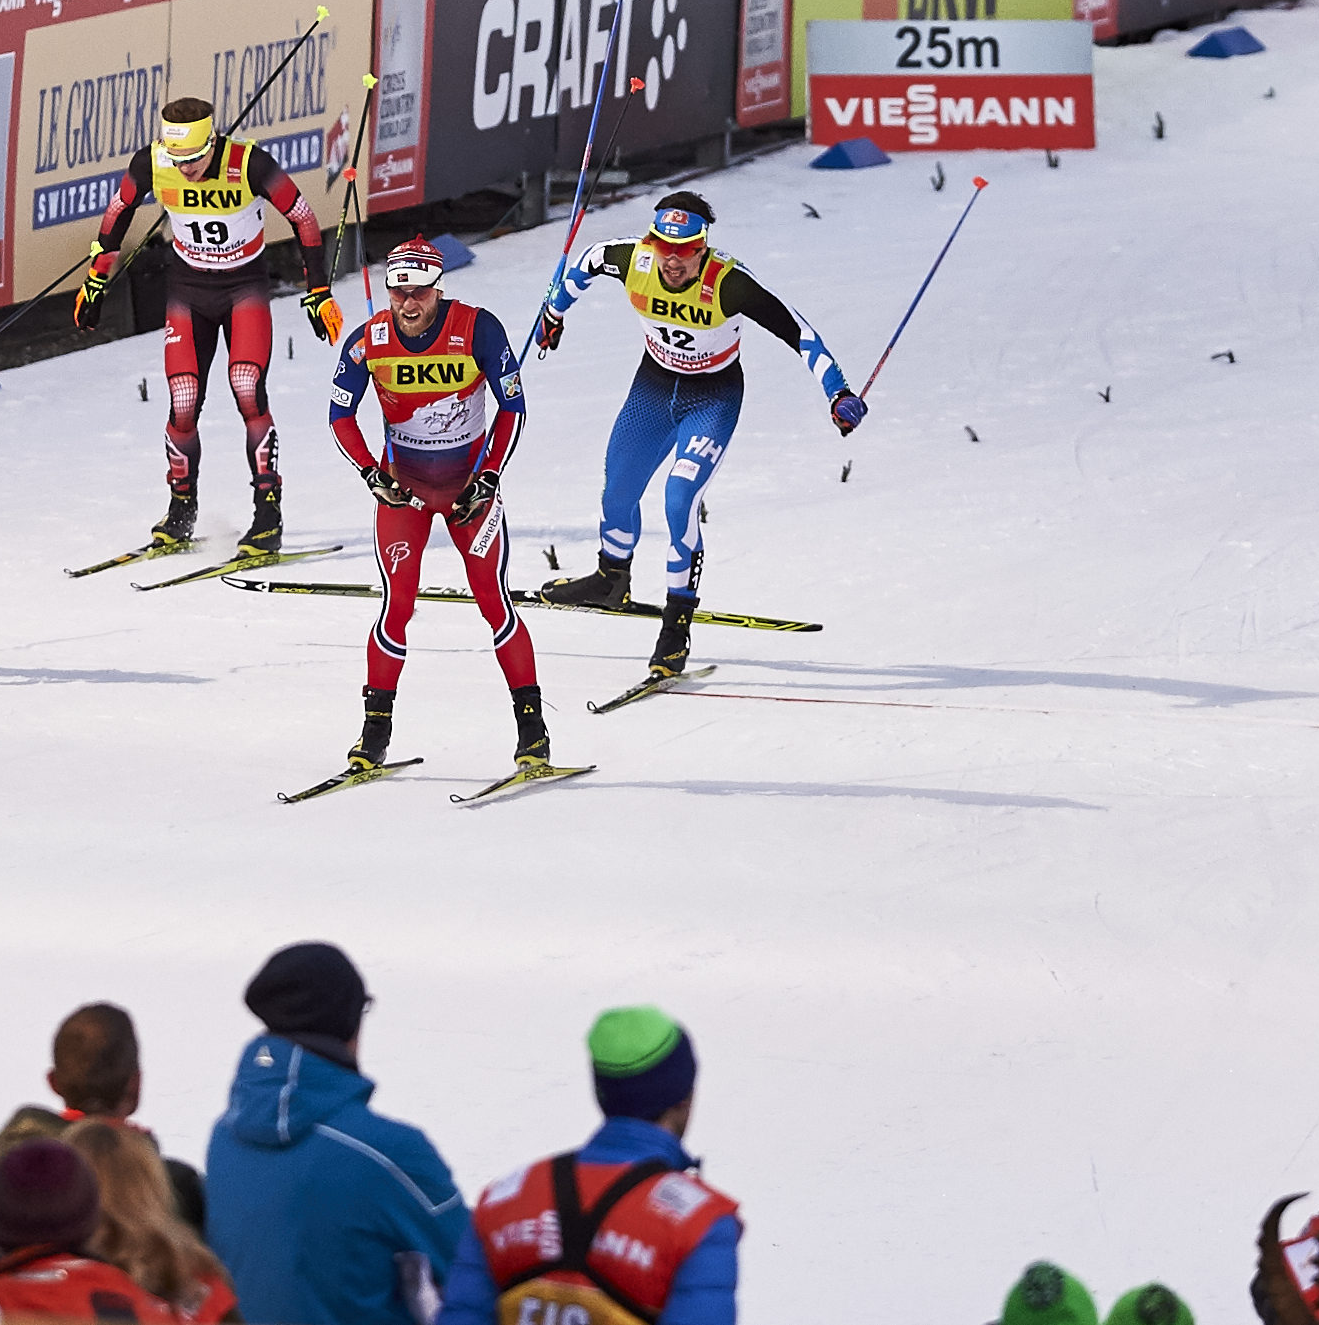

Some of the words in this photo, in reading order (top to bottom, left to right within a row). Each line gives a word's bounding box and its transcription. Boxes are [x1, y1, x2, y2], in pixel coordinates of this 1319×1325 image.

[895, 25, 1000, 69] 25m
[824, 83, 1076, 145] VIESSMANN
[35, 85, 63, 174] LE
[183, 189, 242, 208] BKW
[185, 220, 230, 245] 19
[651, 297, 713, 327] BKW
[653, 326, 697, 352] 12
[396, 363, 465, 385] BKW
[685, 434, 723, 464] HH
